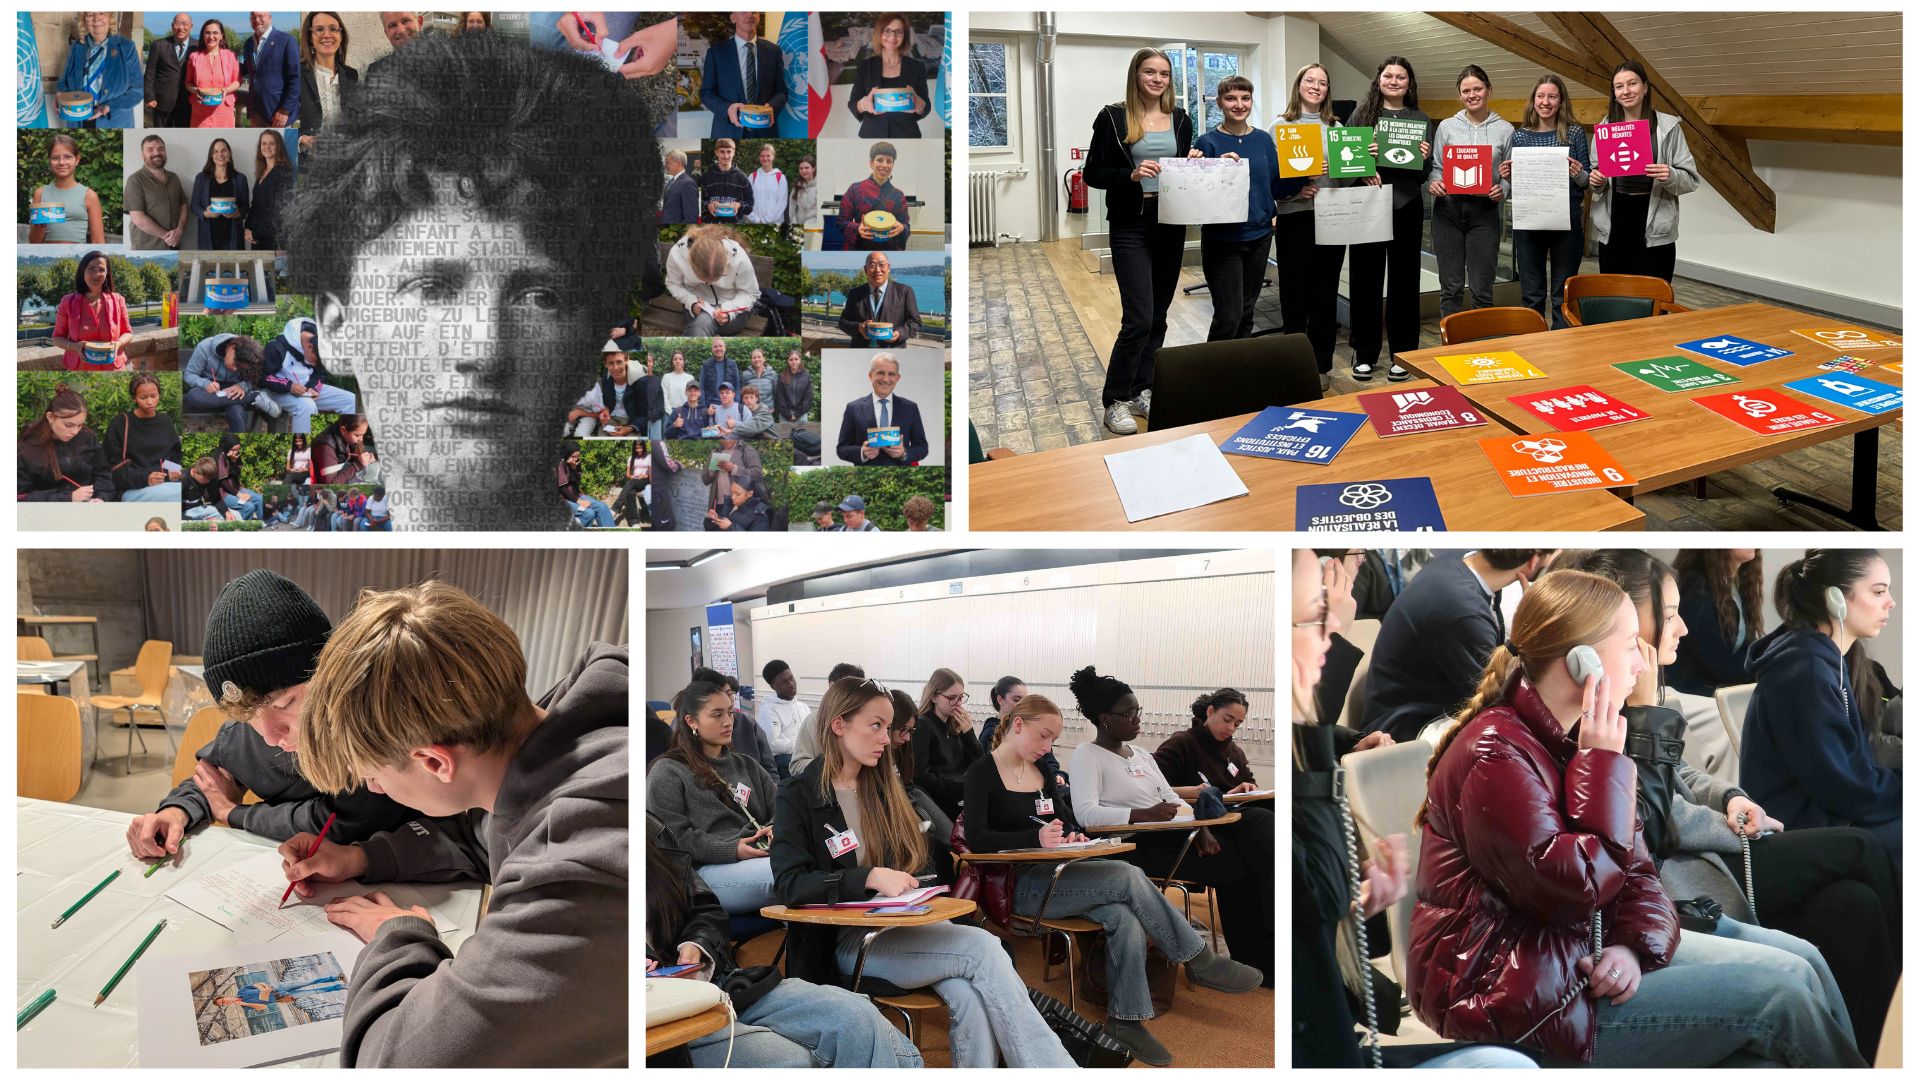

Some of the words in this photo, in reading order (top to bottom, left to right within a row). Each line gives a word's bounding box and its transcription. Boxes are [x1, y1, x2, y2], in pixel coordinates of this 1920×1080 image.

[1378, 120, 1388, 132] 13
[1279, 128, 1286, 140] 2
[1329, 130, 1339, 142] 15
[1596, 127, 1608, 140] 10
[1447, 148, 1452, 159] 4
[1460, 412, 1477, 422] 8
[1620, 408, 1638, 417] 1
[1811, 412, 1836, 421] 5
[1390, 415, 1442, 426] CROISSANCE
[1424, 419, 1459, 427] TRAVAIL
[1391, 423, 1424, 432] DÉCENT
[1233, 436, 1293, 448] INSTITUTIONS
[1265, 434, 1312, 443] EFFICACES
[1236, 444, 1275, 454] JUSTICE
[1304, 444, 1333, 459] 16
[1506, 463, 1590, 477] INFRASTRUCTURE
[1602, 468, 1624, 482] 9
[1526, 475, 1538, 483] ET
[1540, 470, 1596, 481] INNOVATION
[1312, 513, 1372, 524] OBJECTIFS
[1374, 511, 1396, 520] DES
[1308, 520, 1381, 532] RÉALISATION
[1383, 519, 1398, 529] LA
[1203, 560, 1212, 570] 7
[1023, 577, 1030, 586] 6
[899, 591, 904, 599] 5
